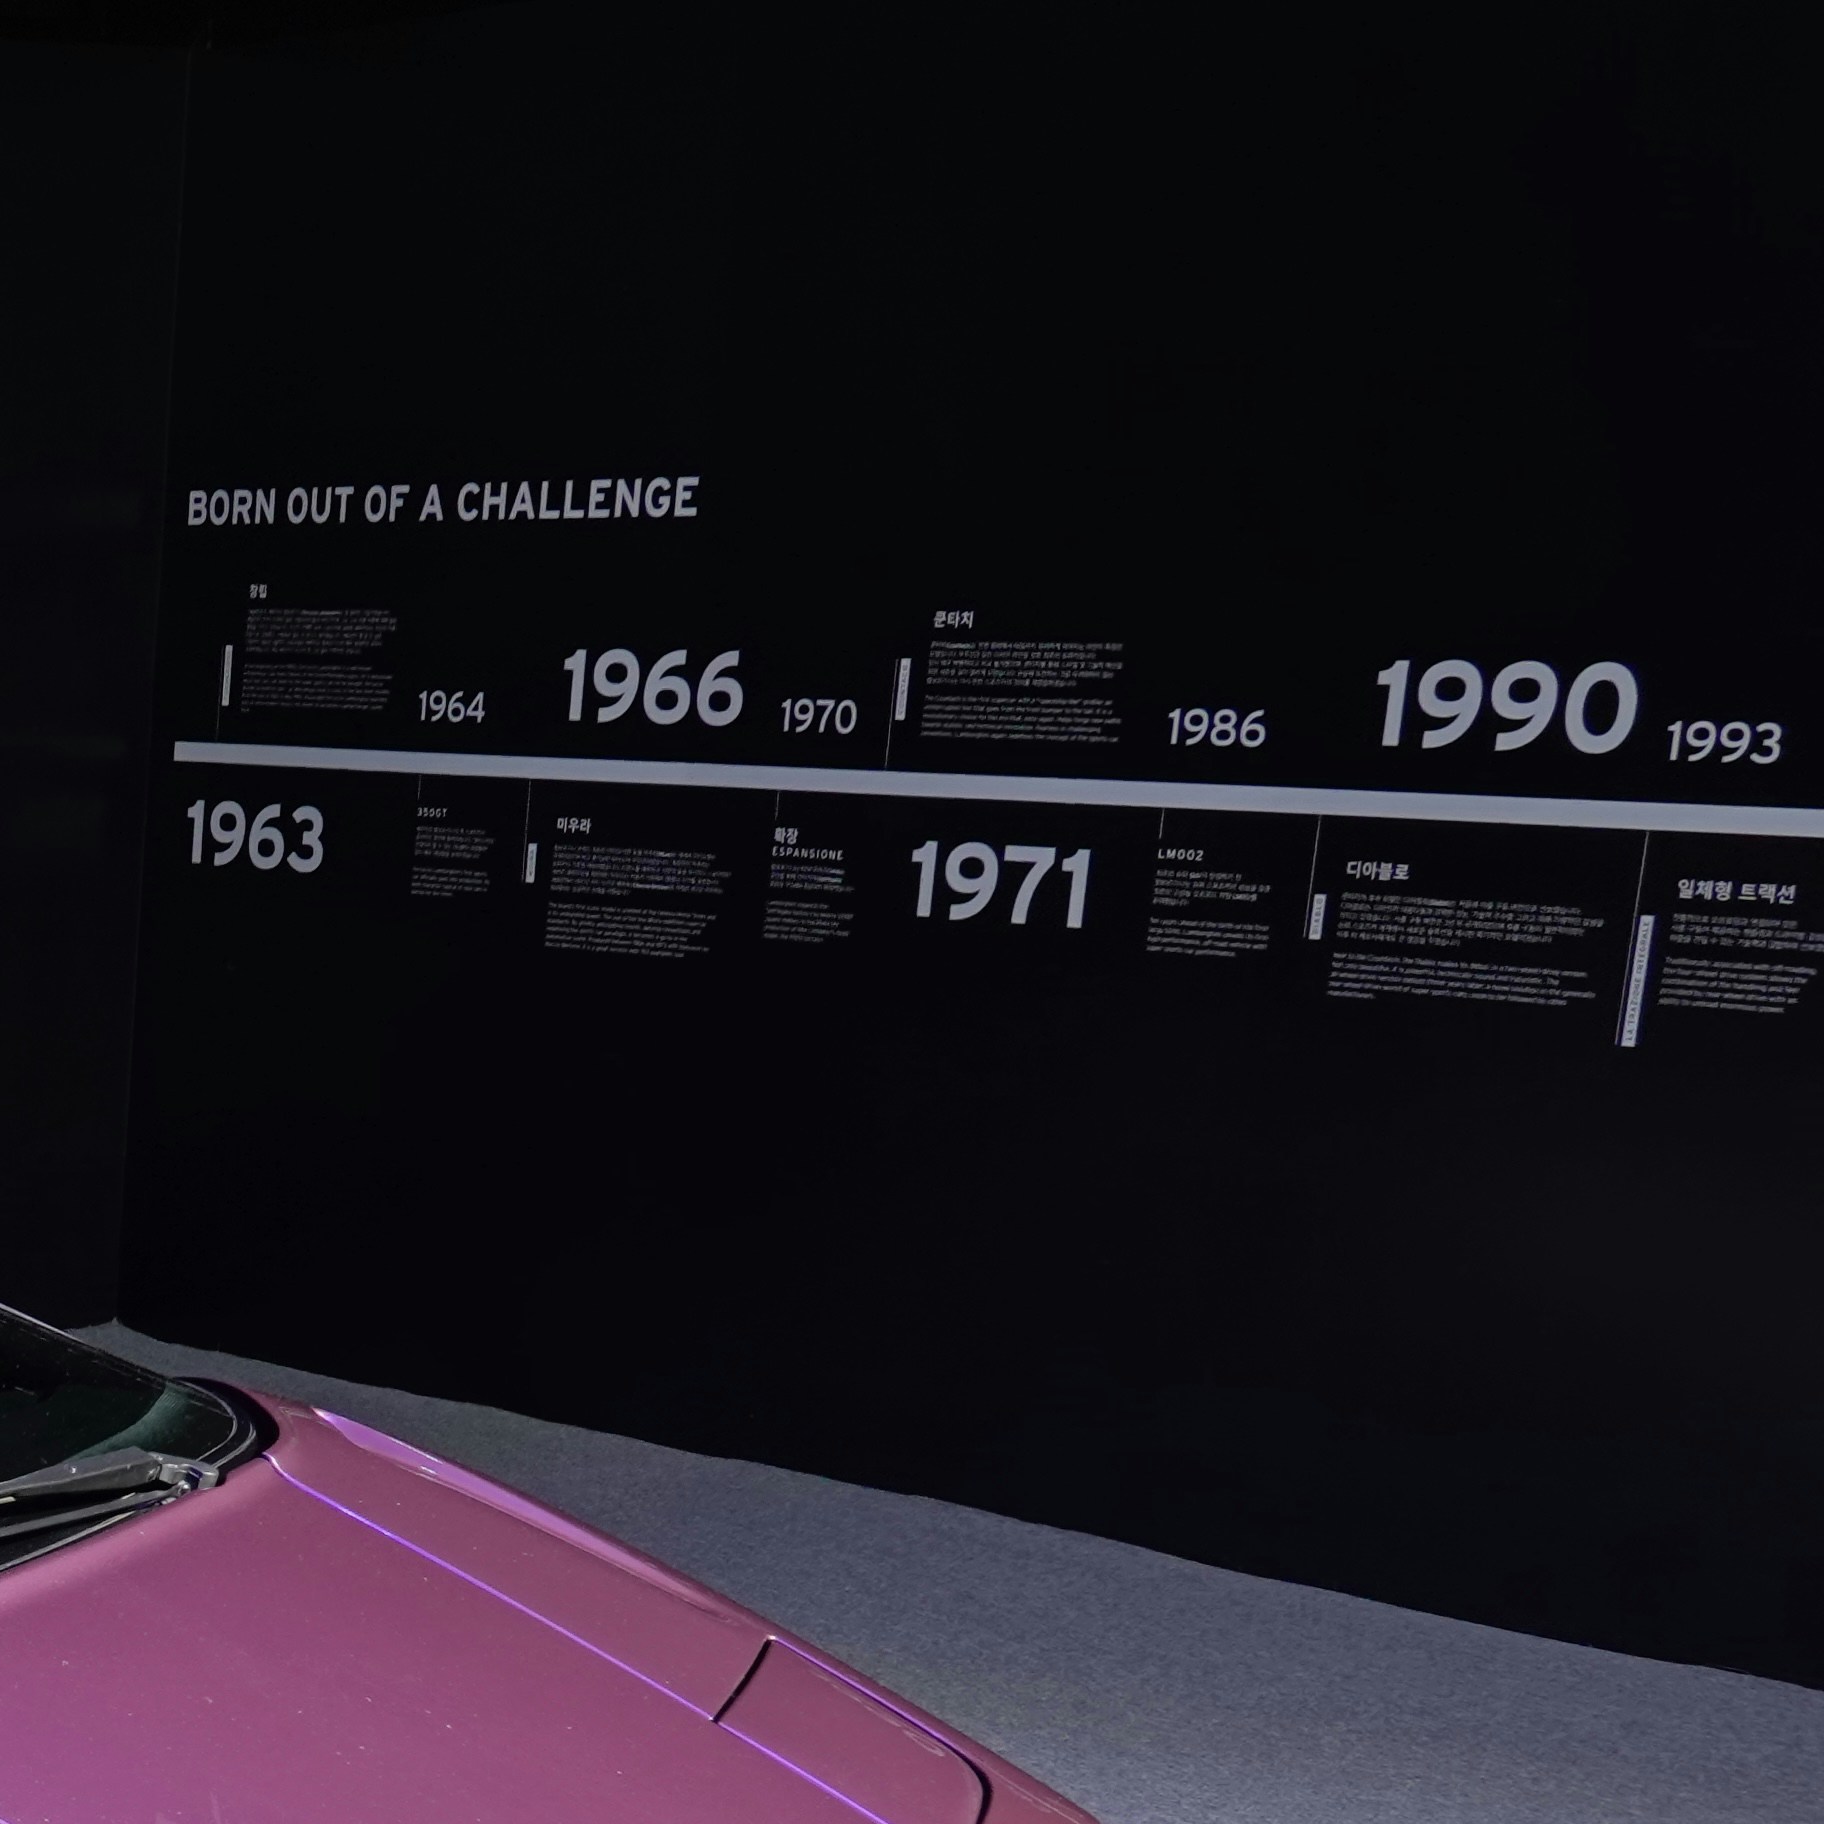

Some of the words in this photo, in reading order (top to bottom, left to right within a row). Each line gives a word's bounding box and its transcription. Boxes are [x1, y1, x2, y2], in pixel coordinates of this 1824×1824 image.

[188, 488, 275, 525] BORN
[288, 487, 354, 523] OUT
[365, 485, 410, 522] OF
[419, 484, 443, 521] A
[458, 477, 699, 521] CHALLENGE
[933, 610, 974, 629] 쿤타치
[564, 649, 743, 726] 1966
[419, 690, 485, 722] 1964
[782, 698, 857, 734] 1970
[1377, 660, 1638, 754] 1990
[1169, 708, 1265, 747] 1986
[1668, 721, 1782, 764] 1993
[188, 800, 323, 872] 1963
[556, 817, 592, 834] 미우라
[773, 827, 799, 845] 확장
[772, 846, 843, 861] ESPANSIONE
[1157, 848, 1204, 862] LM002
[1346, 860, 1409, 881] 디아블로
[912, 841, 1091, 928] 1971
[1677, 878, 1734, 902] 일체형
[1737, 883, 1798, 905] 트랙션
